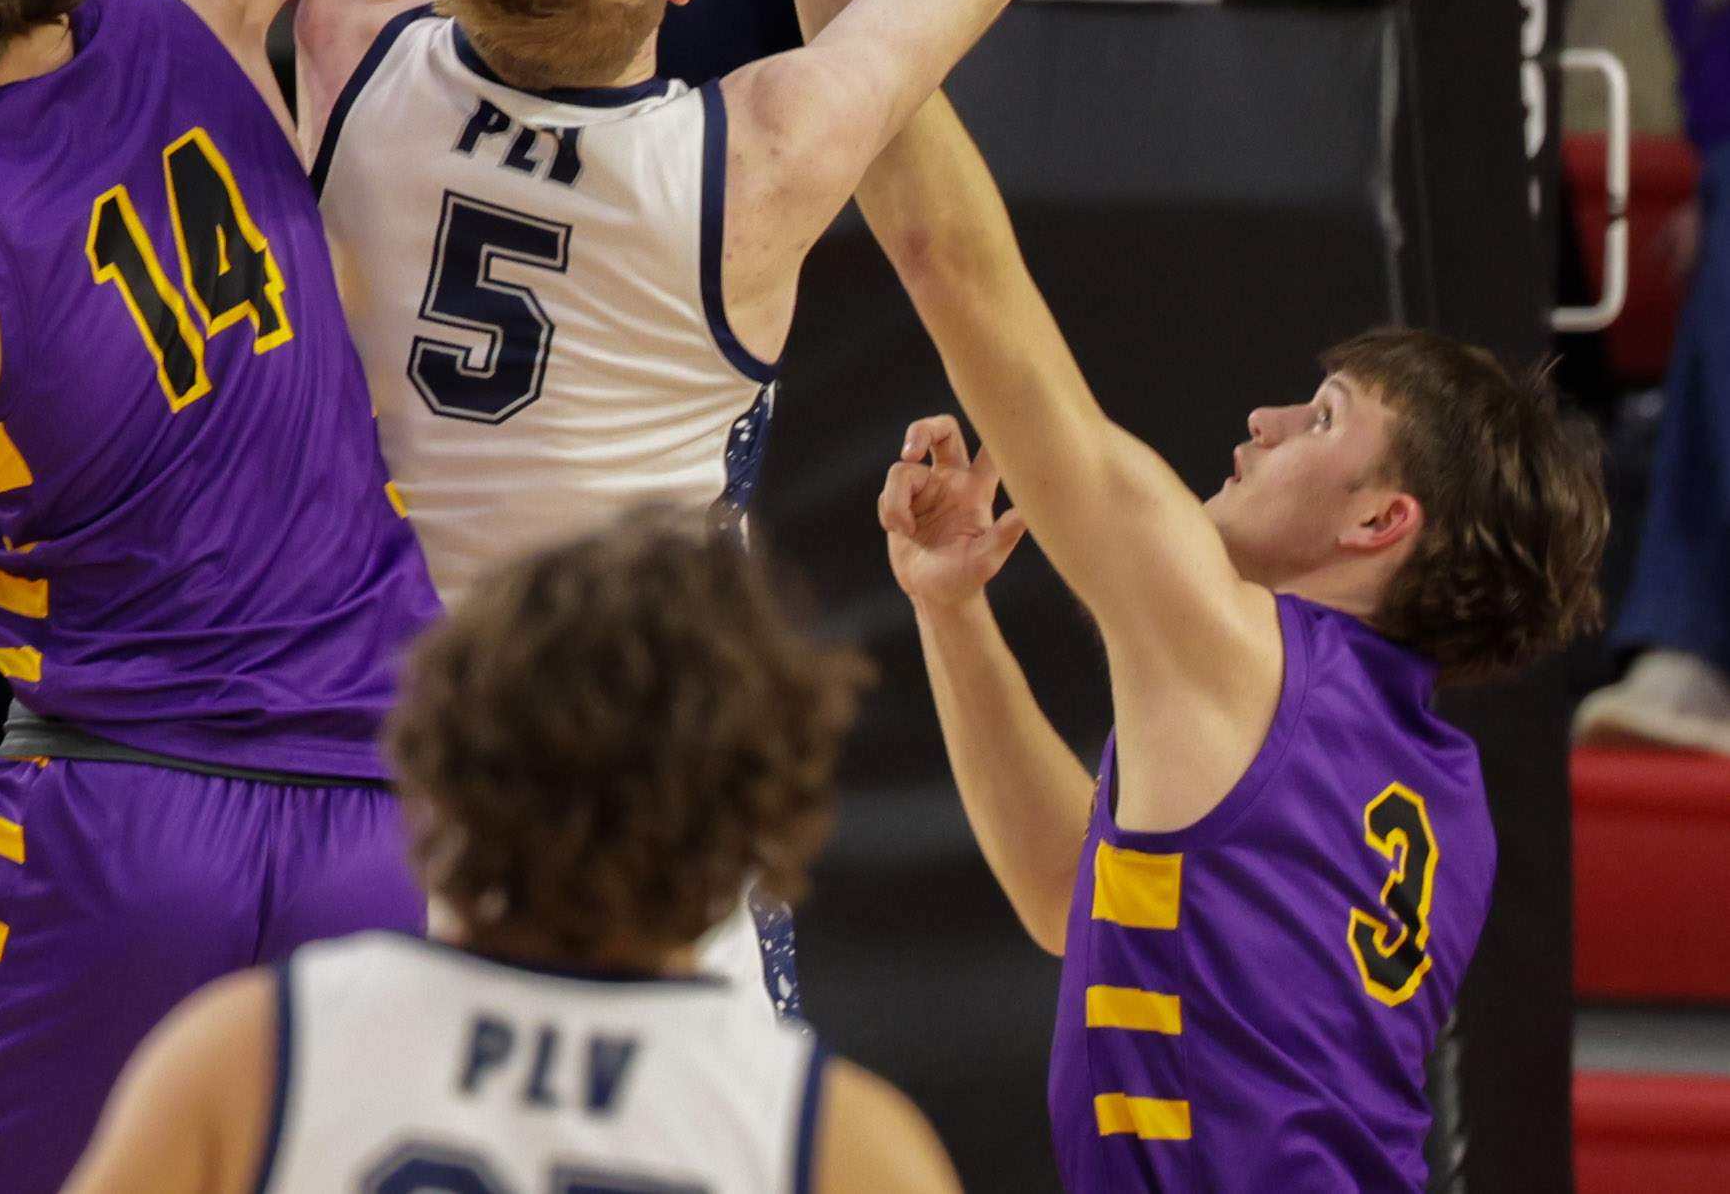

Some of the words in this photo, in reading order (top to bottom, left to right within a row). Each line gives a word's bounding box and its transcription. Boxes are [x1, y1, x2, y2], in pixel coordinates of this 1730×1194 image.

[450, 98, 586, 189] PLV
[85, 126, 294, 414] 14
[406, 187, 573, 426] 5
[1347, 780, 1440, 1007] 3
[457, 1014, 641, 1115] PLV
